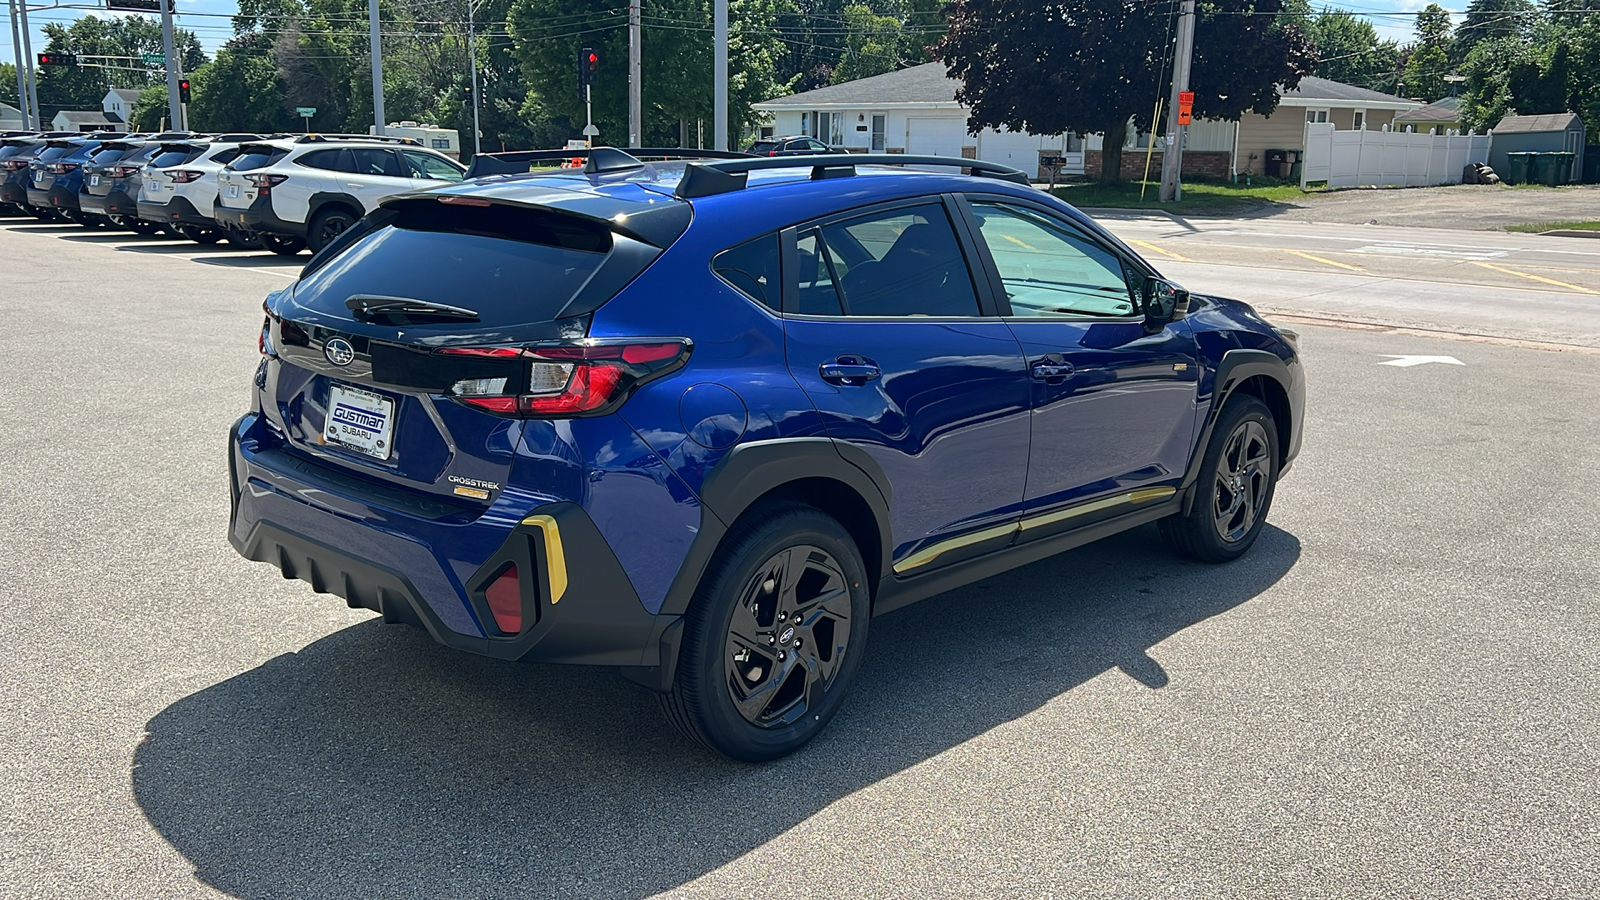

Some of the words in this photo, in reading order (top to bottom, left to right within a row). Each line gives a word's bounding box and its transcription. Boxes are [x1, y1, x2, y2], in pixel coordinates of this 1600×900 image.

[147, 55, 166, 63] Spence
[341, 425, 372, 440] SUBARU
[447, 475, 500, 490] CROSSTREK
